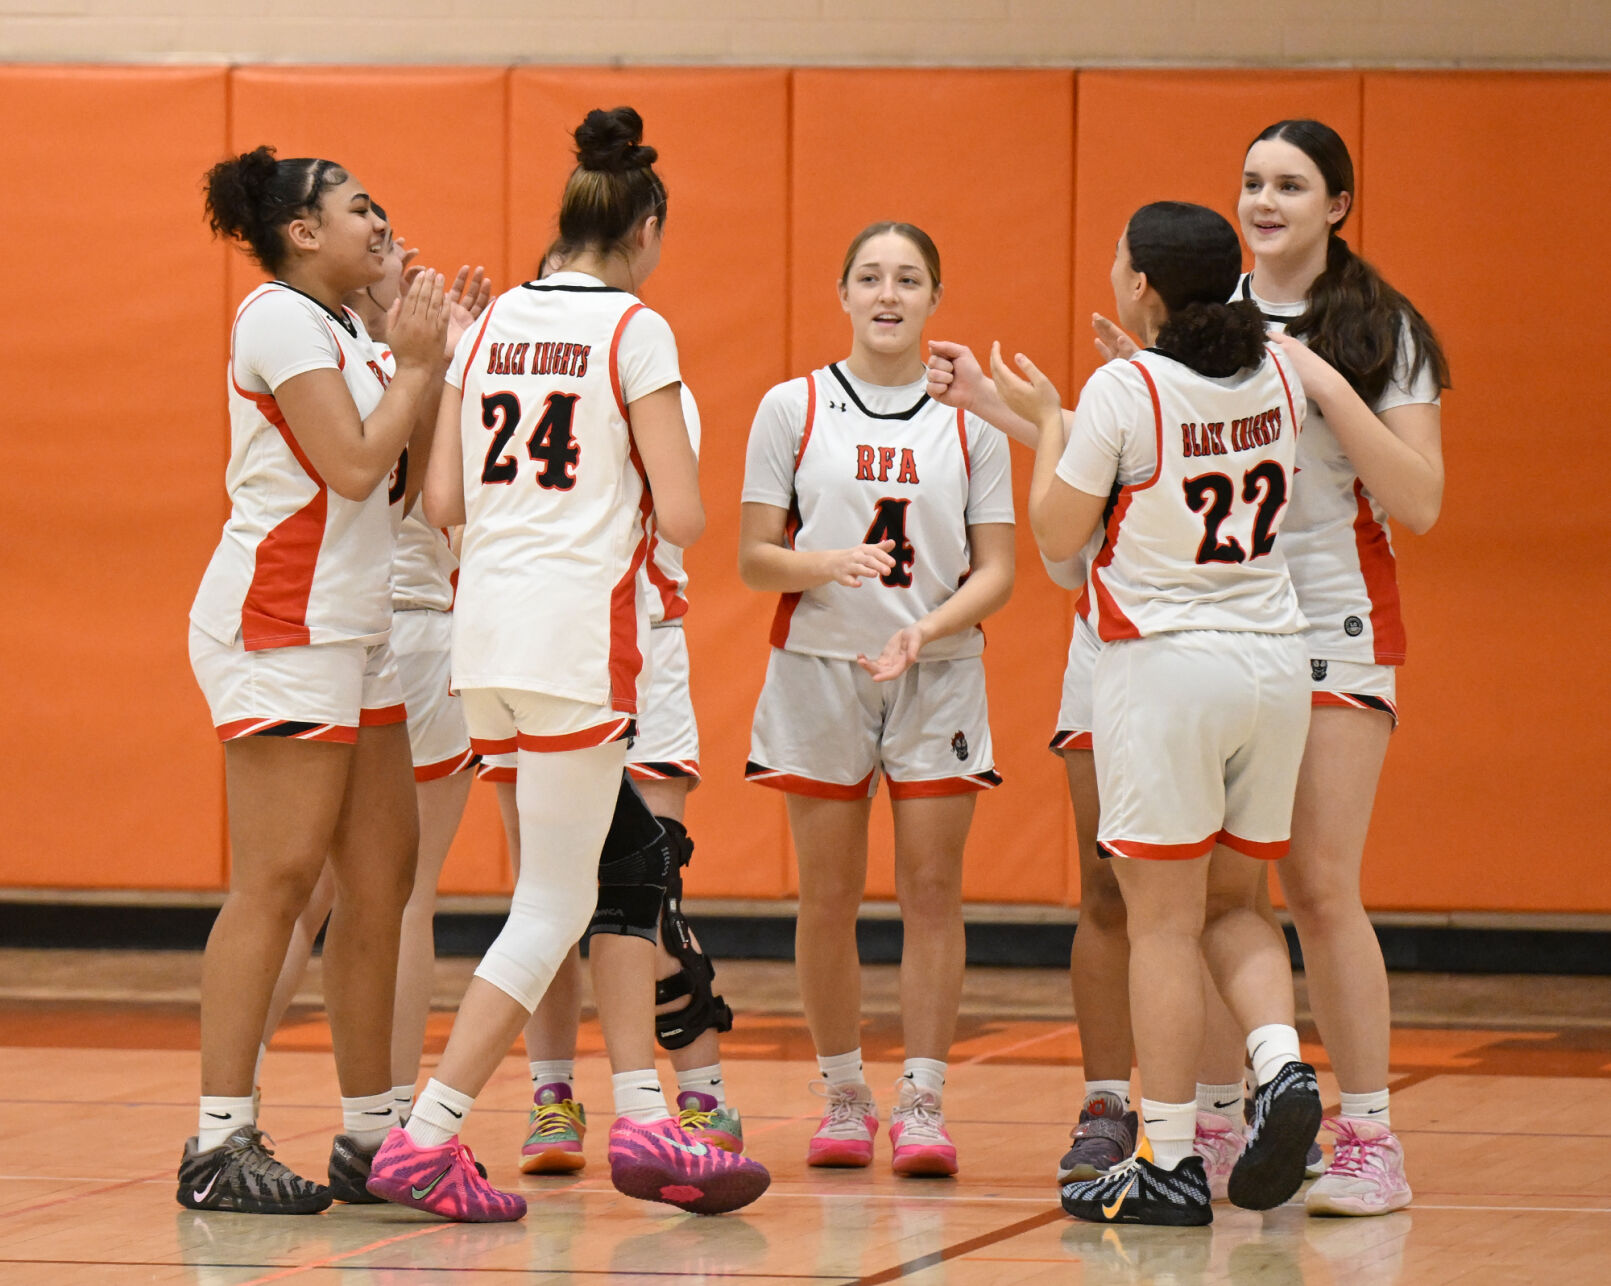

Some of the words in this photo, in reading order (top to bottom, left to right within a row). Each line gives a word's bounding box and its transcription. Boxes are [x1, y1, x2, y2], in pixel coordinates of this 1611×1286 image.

[487, 342, 530, 375] BLACK
[531, 342, 592, 378] KNIGHTS
[481, 390, 582, 492] 24
[856, 444, 920, 484] RFA
[1181, 421, 1228, 457] BLACK
[1231, 406, 1282, 452] KNIGHTS
[862, 496, 915, 588] 4
[1182, 459, 1287, 564] 22
